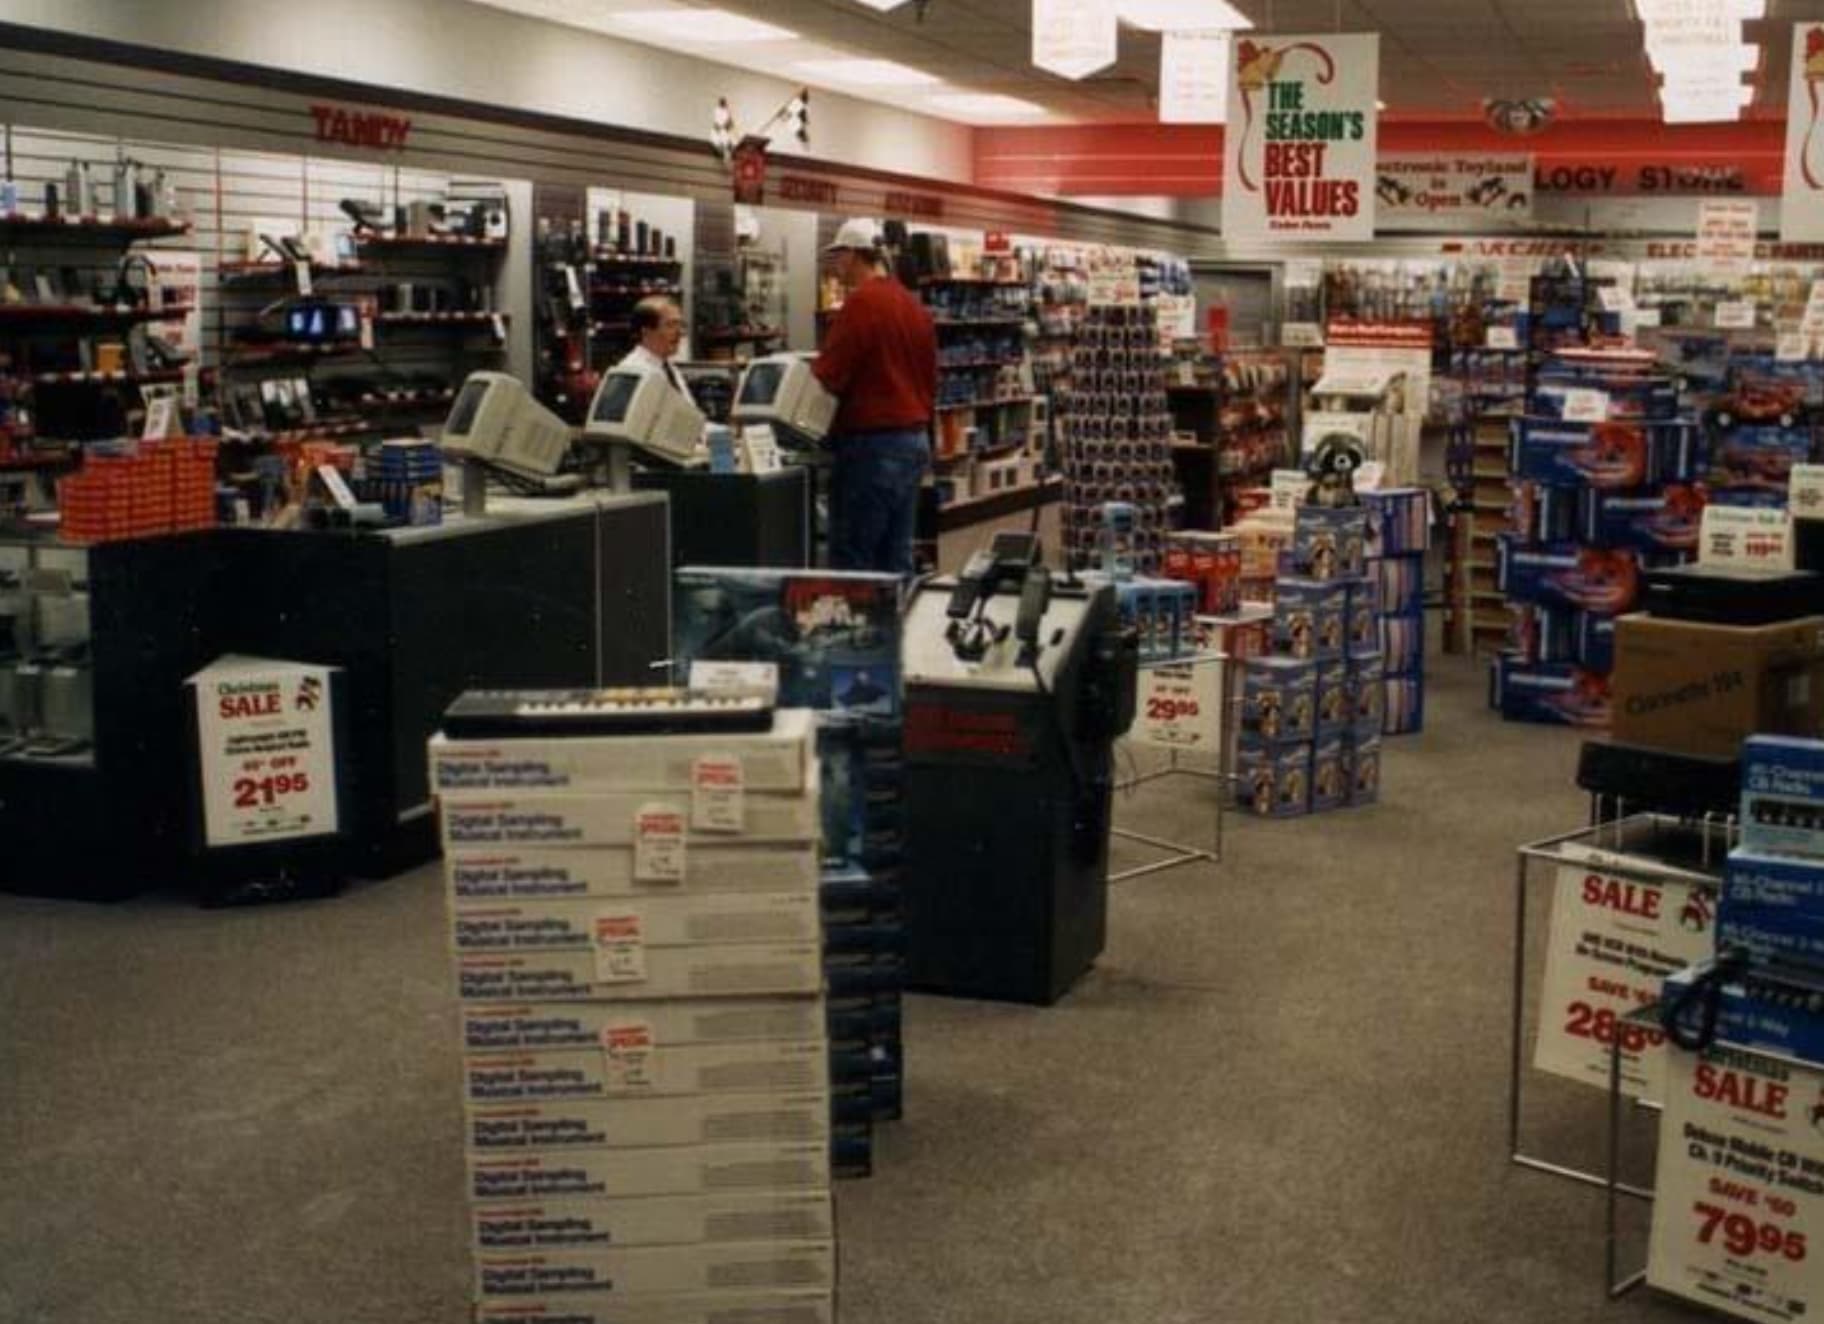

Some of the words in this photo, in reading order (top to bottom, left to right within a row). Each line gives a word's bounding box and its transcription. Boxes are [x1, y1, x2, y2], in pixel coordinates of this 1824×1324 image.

[1267, 81, 1304, 109] THE
[311, 104, 411, 150] TANDY
[1265, 111, 1364, 140] SEASON'S
[1264, 142, 1328, 178] BEST
[1376, 160, 1447, 173] ectronic
[1533, 165, 1617, 191] LOGY
[1264, 180, 1359, 216] VALUES
[219, 694, 281, 718] SALE
[234, 772, 308, 808] 2195
[1582, 874, 1662, 920] SALE
[1588, 975, 1629, 999] SAVE
[1693, 1062, 1790, 1119] SALE
[1725, 1152, 1775, 1185] Priority
[1709, 1176, 1758, 1206] SAVE
[1692, 1200, 1807, 1262] 7995
